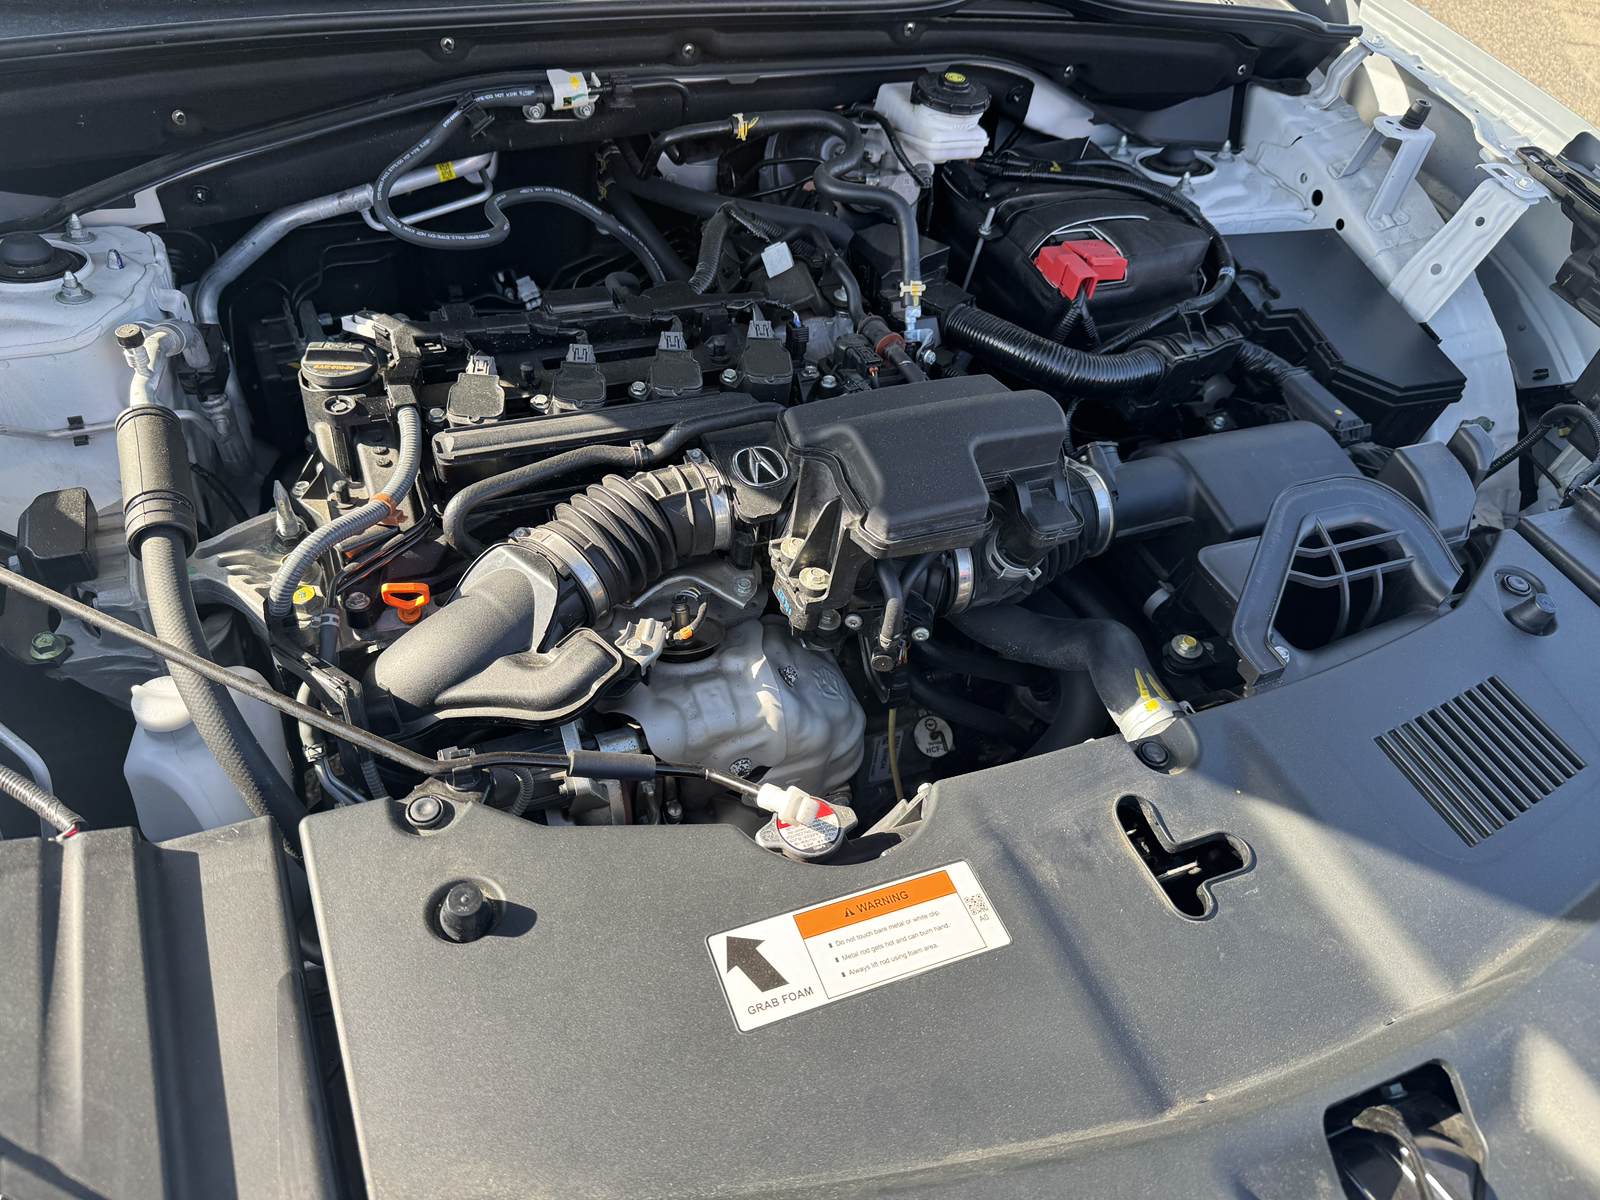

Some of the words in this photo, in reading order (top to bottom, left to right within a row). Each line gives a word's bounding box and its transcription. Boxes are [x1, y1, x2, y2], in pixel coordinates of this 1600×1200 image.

[855, 890, 909, 912] WARNING
[841, 951, 859, 961] Metal
[871, 944, 885, 953] gets
[884, 940, 896, 948] hot
[895, 936, 908, 944] and
[908, 932, 919, 940] can
[919, 928, 934, 937] burn
[933, 922, 951, 932] hand.
[845, 936, 856, 944] not
[856, 931, 874, 940] touch
[874, 926, 888, 934] bare
[888, 920, 905, 930] metal
[913, 913, 929, 923] white
[929, 909, 941, 918] clip.
[849, 965, 871, 976] Always
[870, 961, 880, 969] lift
[879, 957, 890, 965] rod
[890, 952, 908, 962] using
[907, 947, 924, 957] foam
[924, 942, 940, 951] area.
[747, 997, 780, 1015] GRAB
[781, 986, 814, 1004] FOAM
